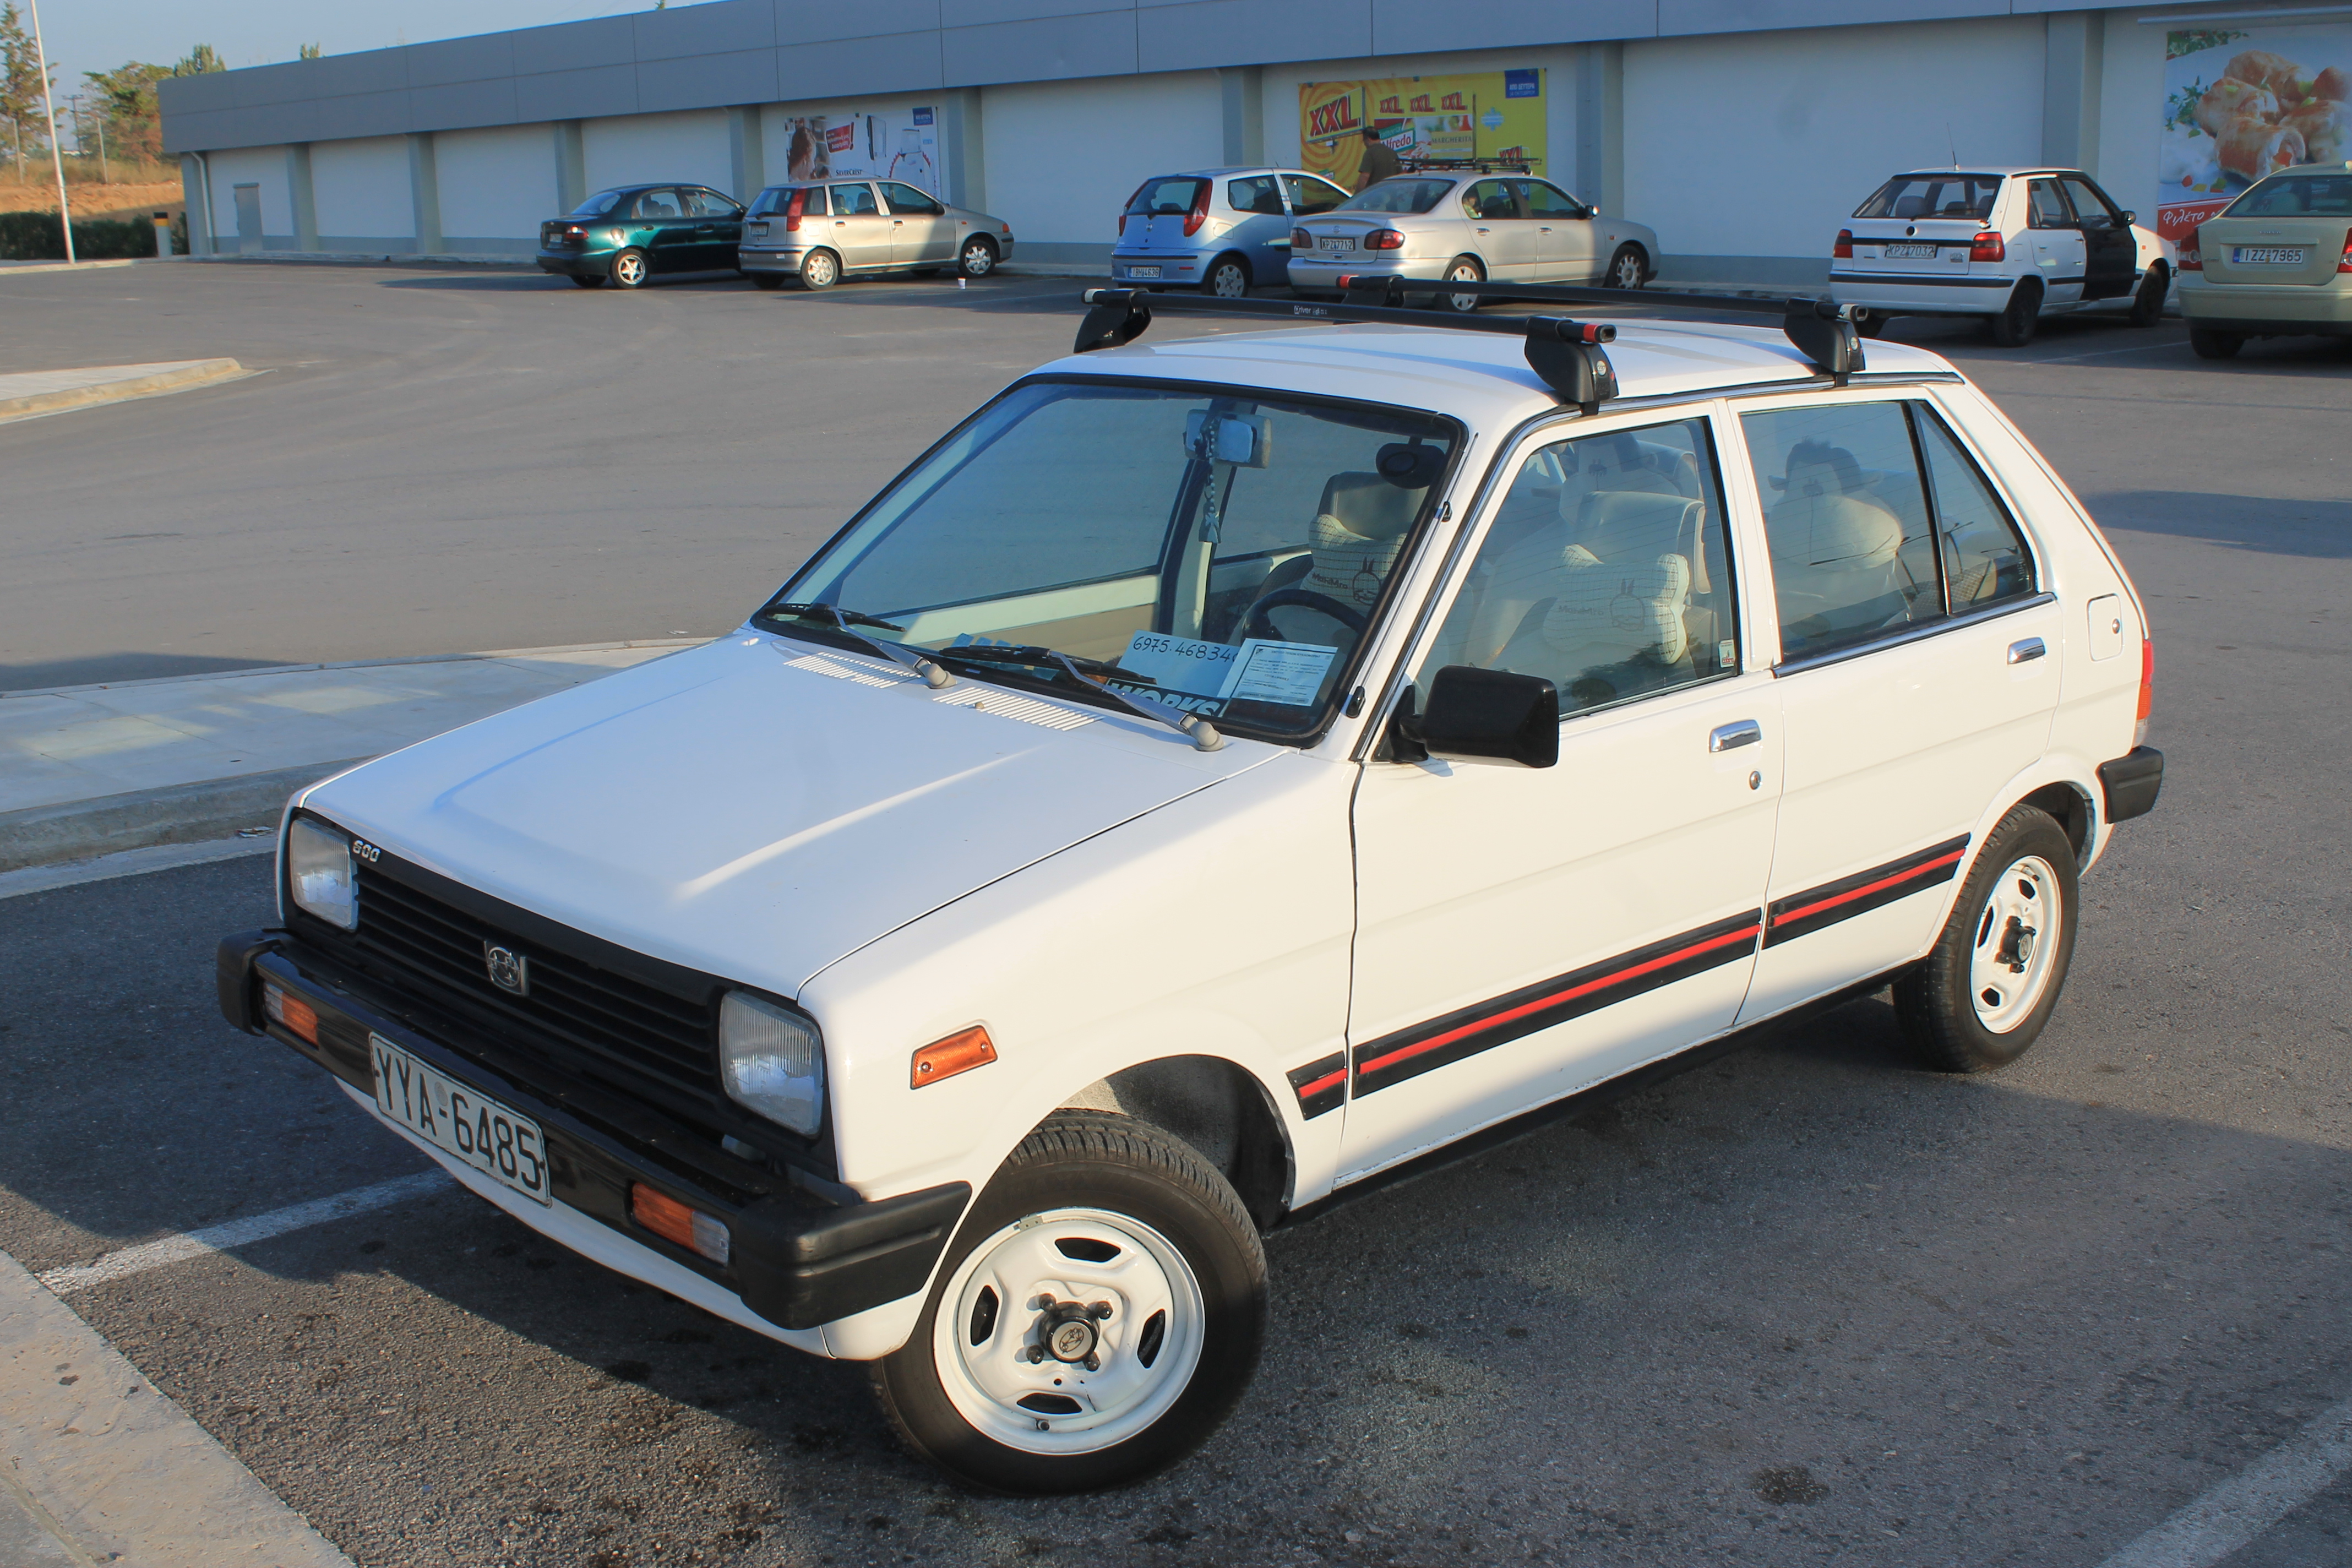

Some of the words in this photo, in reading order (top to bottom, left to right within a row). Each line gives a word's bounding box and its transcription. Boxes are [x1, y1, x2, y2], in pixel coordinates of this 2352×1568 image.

[1380, 95, 1404, 114] XXL
[1409, 93, 1436, 113] XXL
[1441, 91, 1468, 111] XXL
[1309, 95, 1360, 137] XXL
[2163, 209, 2204, 226] Φιλέτο
[353, 840, 381, 862] 600
